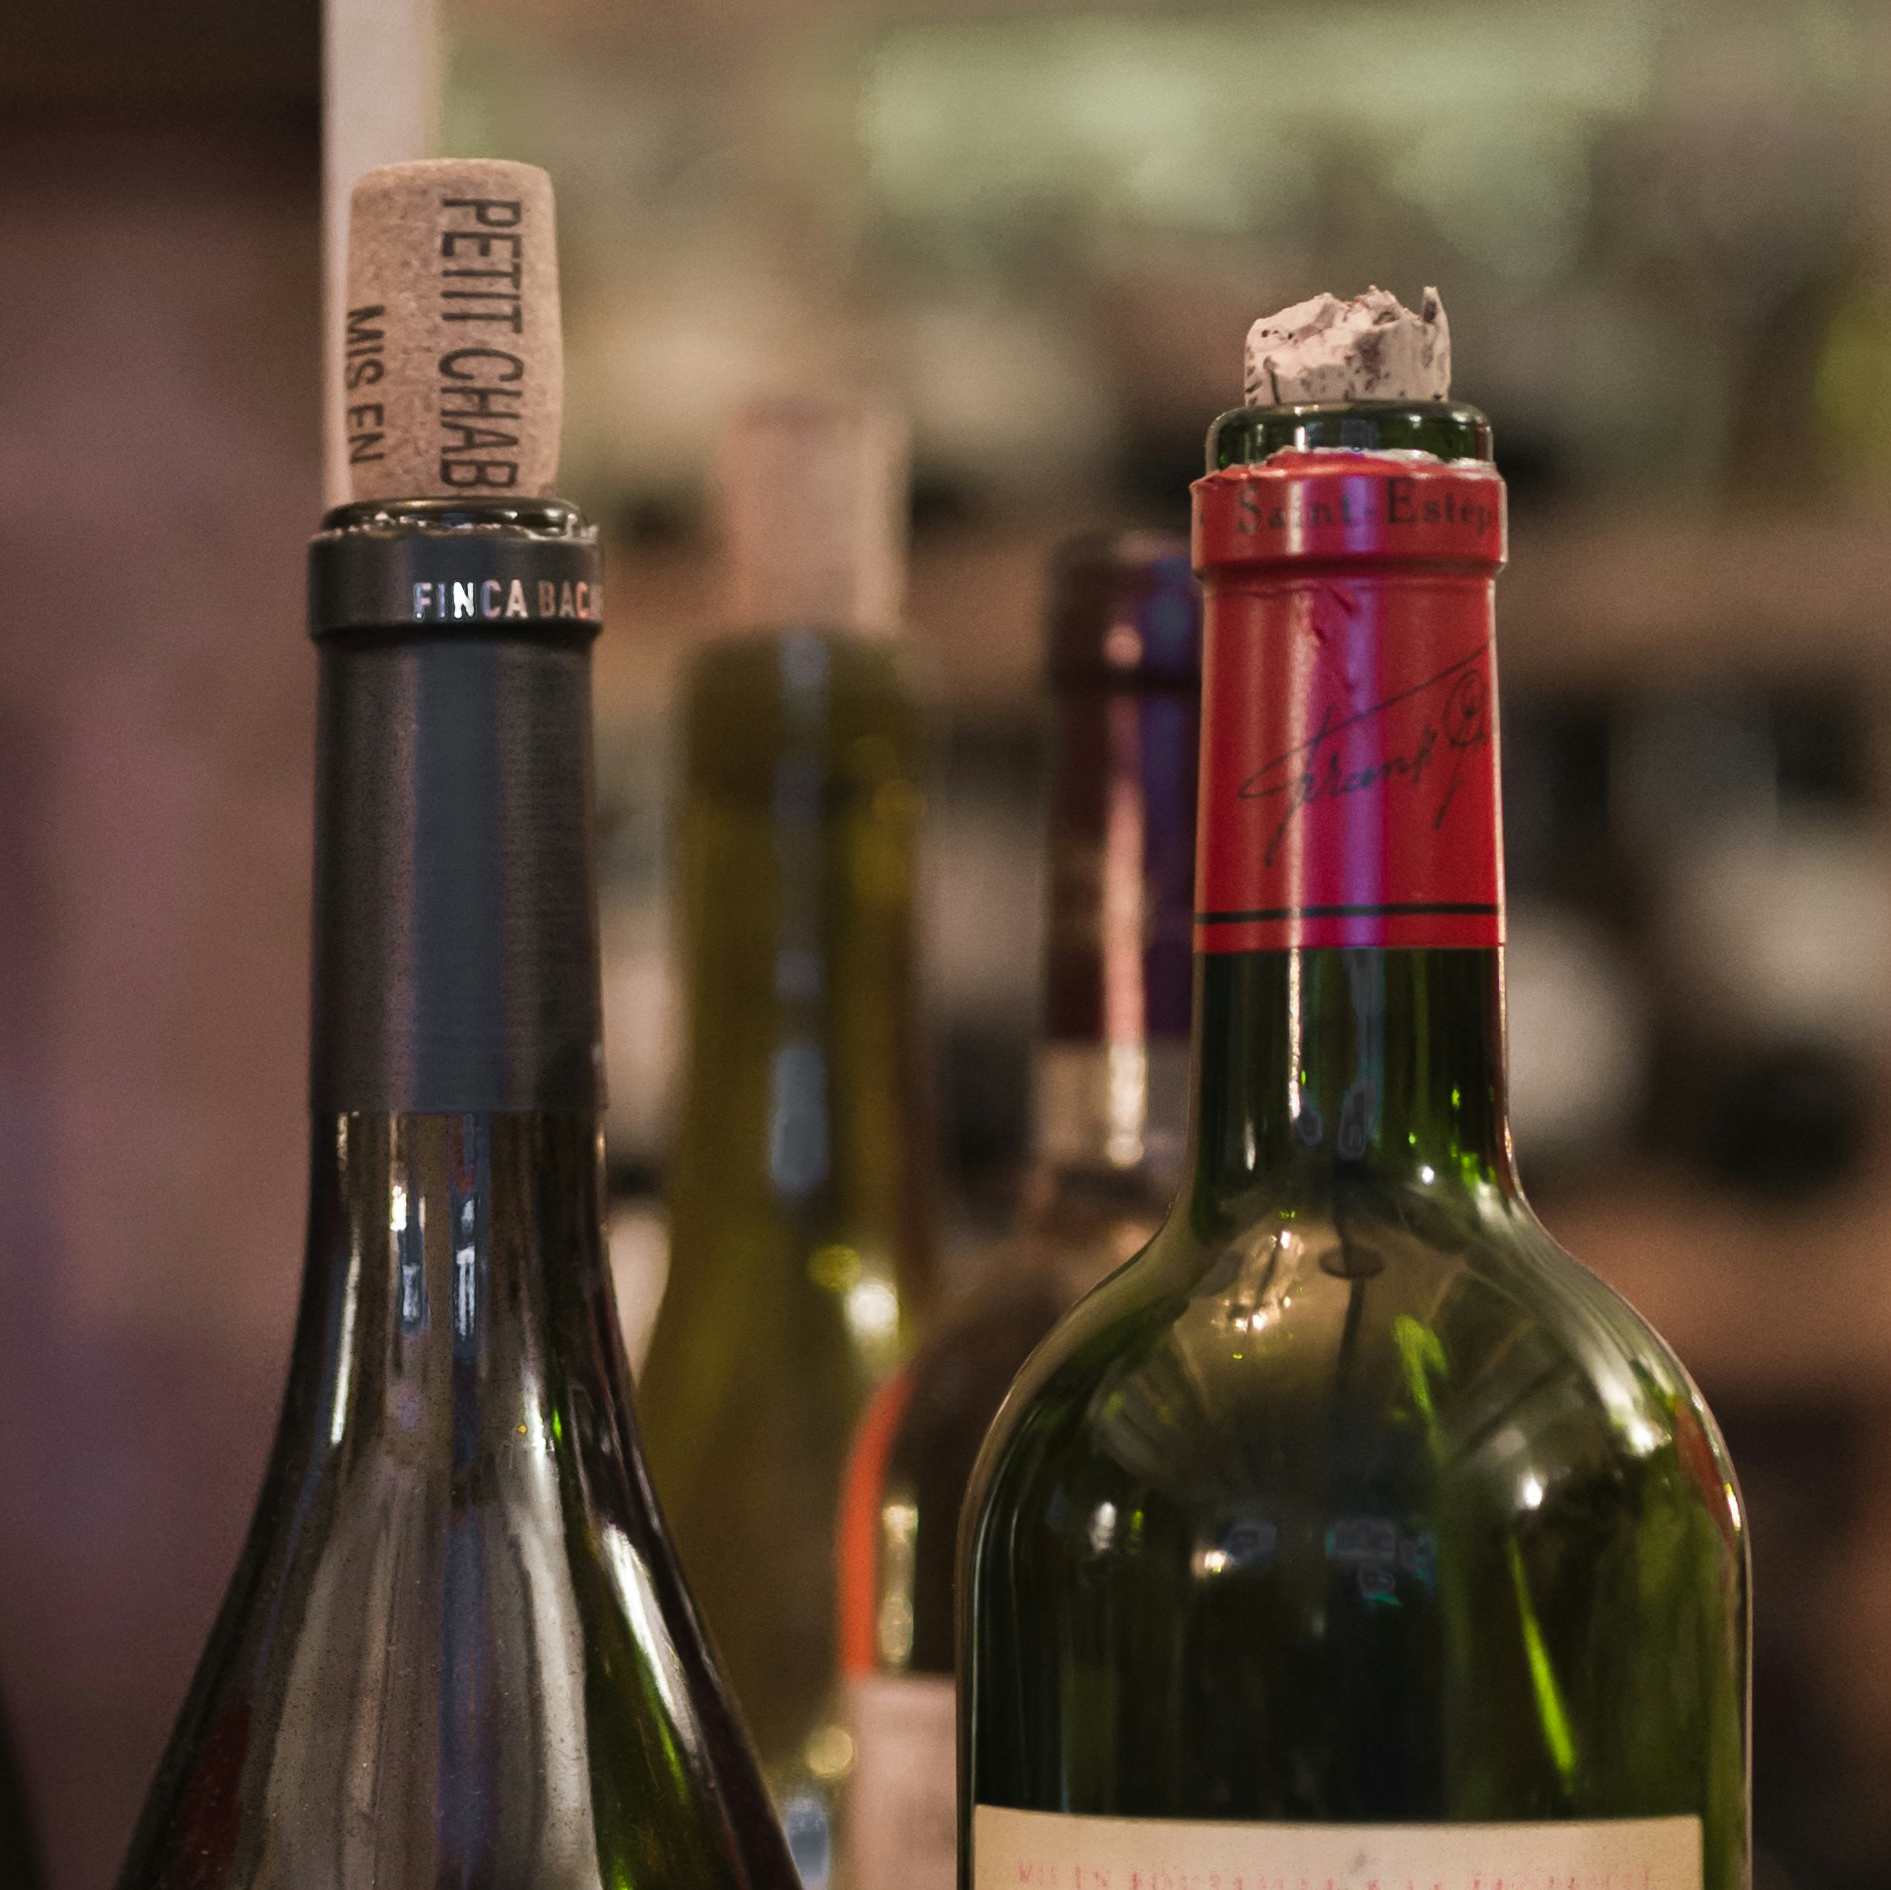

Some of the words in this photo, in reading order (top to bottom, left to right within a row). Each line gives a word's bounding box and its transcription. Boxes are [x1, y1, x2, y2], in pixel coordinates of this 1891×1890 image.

[440, 199, 523, 334] PETIT
[346, 304, 385, 391] MIS
[349, 403, 385, 464] EN
[438, 348, 524, 489] CHAB
[413, 579, 529, 620] FINCA
